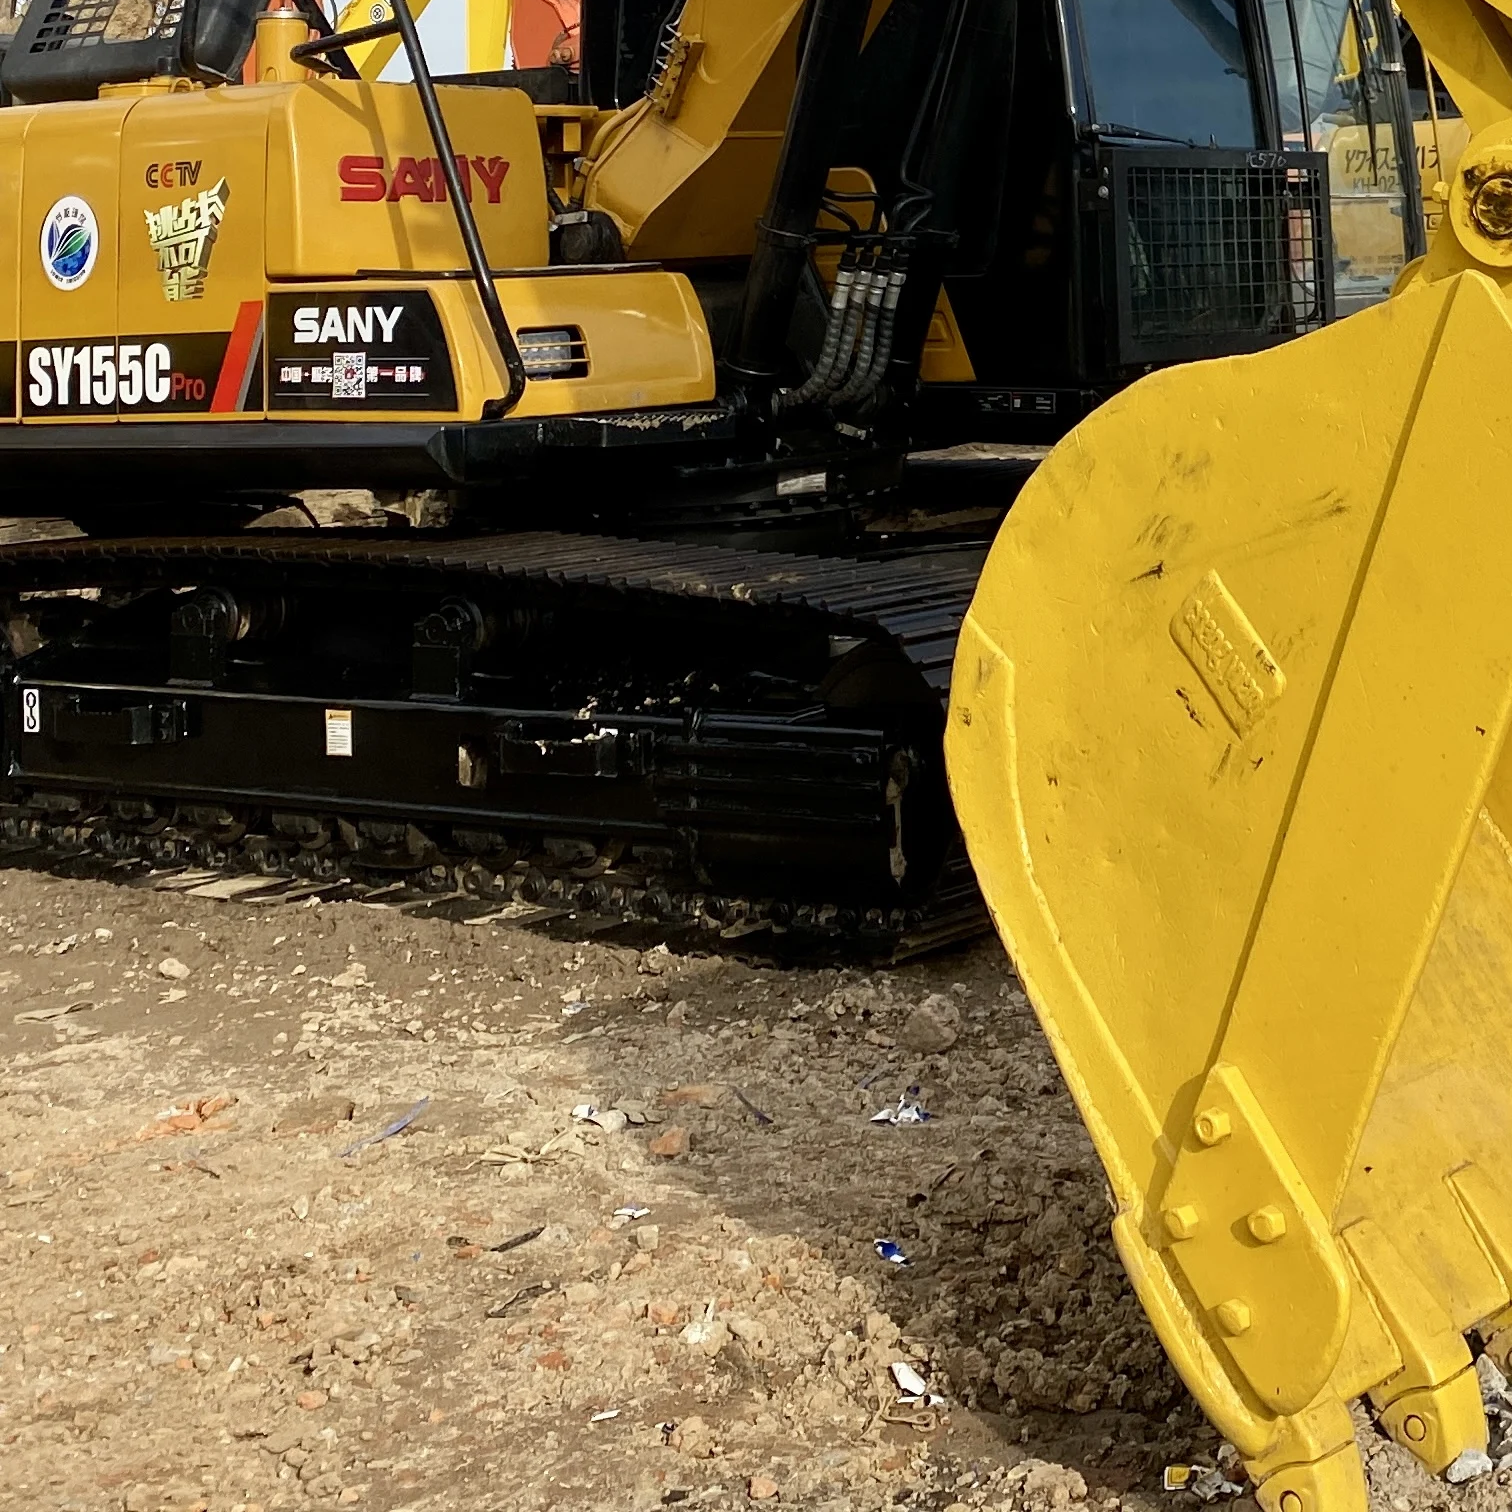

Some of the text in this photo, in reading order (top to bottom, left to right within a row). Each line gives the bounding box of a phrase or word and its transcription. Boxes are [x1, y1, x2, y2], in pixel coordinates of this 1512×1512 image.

[146, 160, 202, 188] CCTV
[338, 155, 510, 204] SANY
[293, 306, 404, 344] SANY
[28, 342, 206, 407] SY155C Pro
